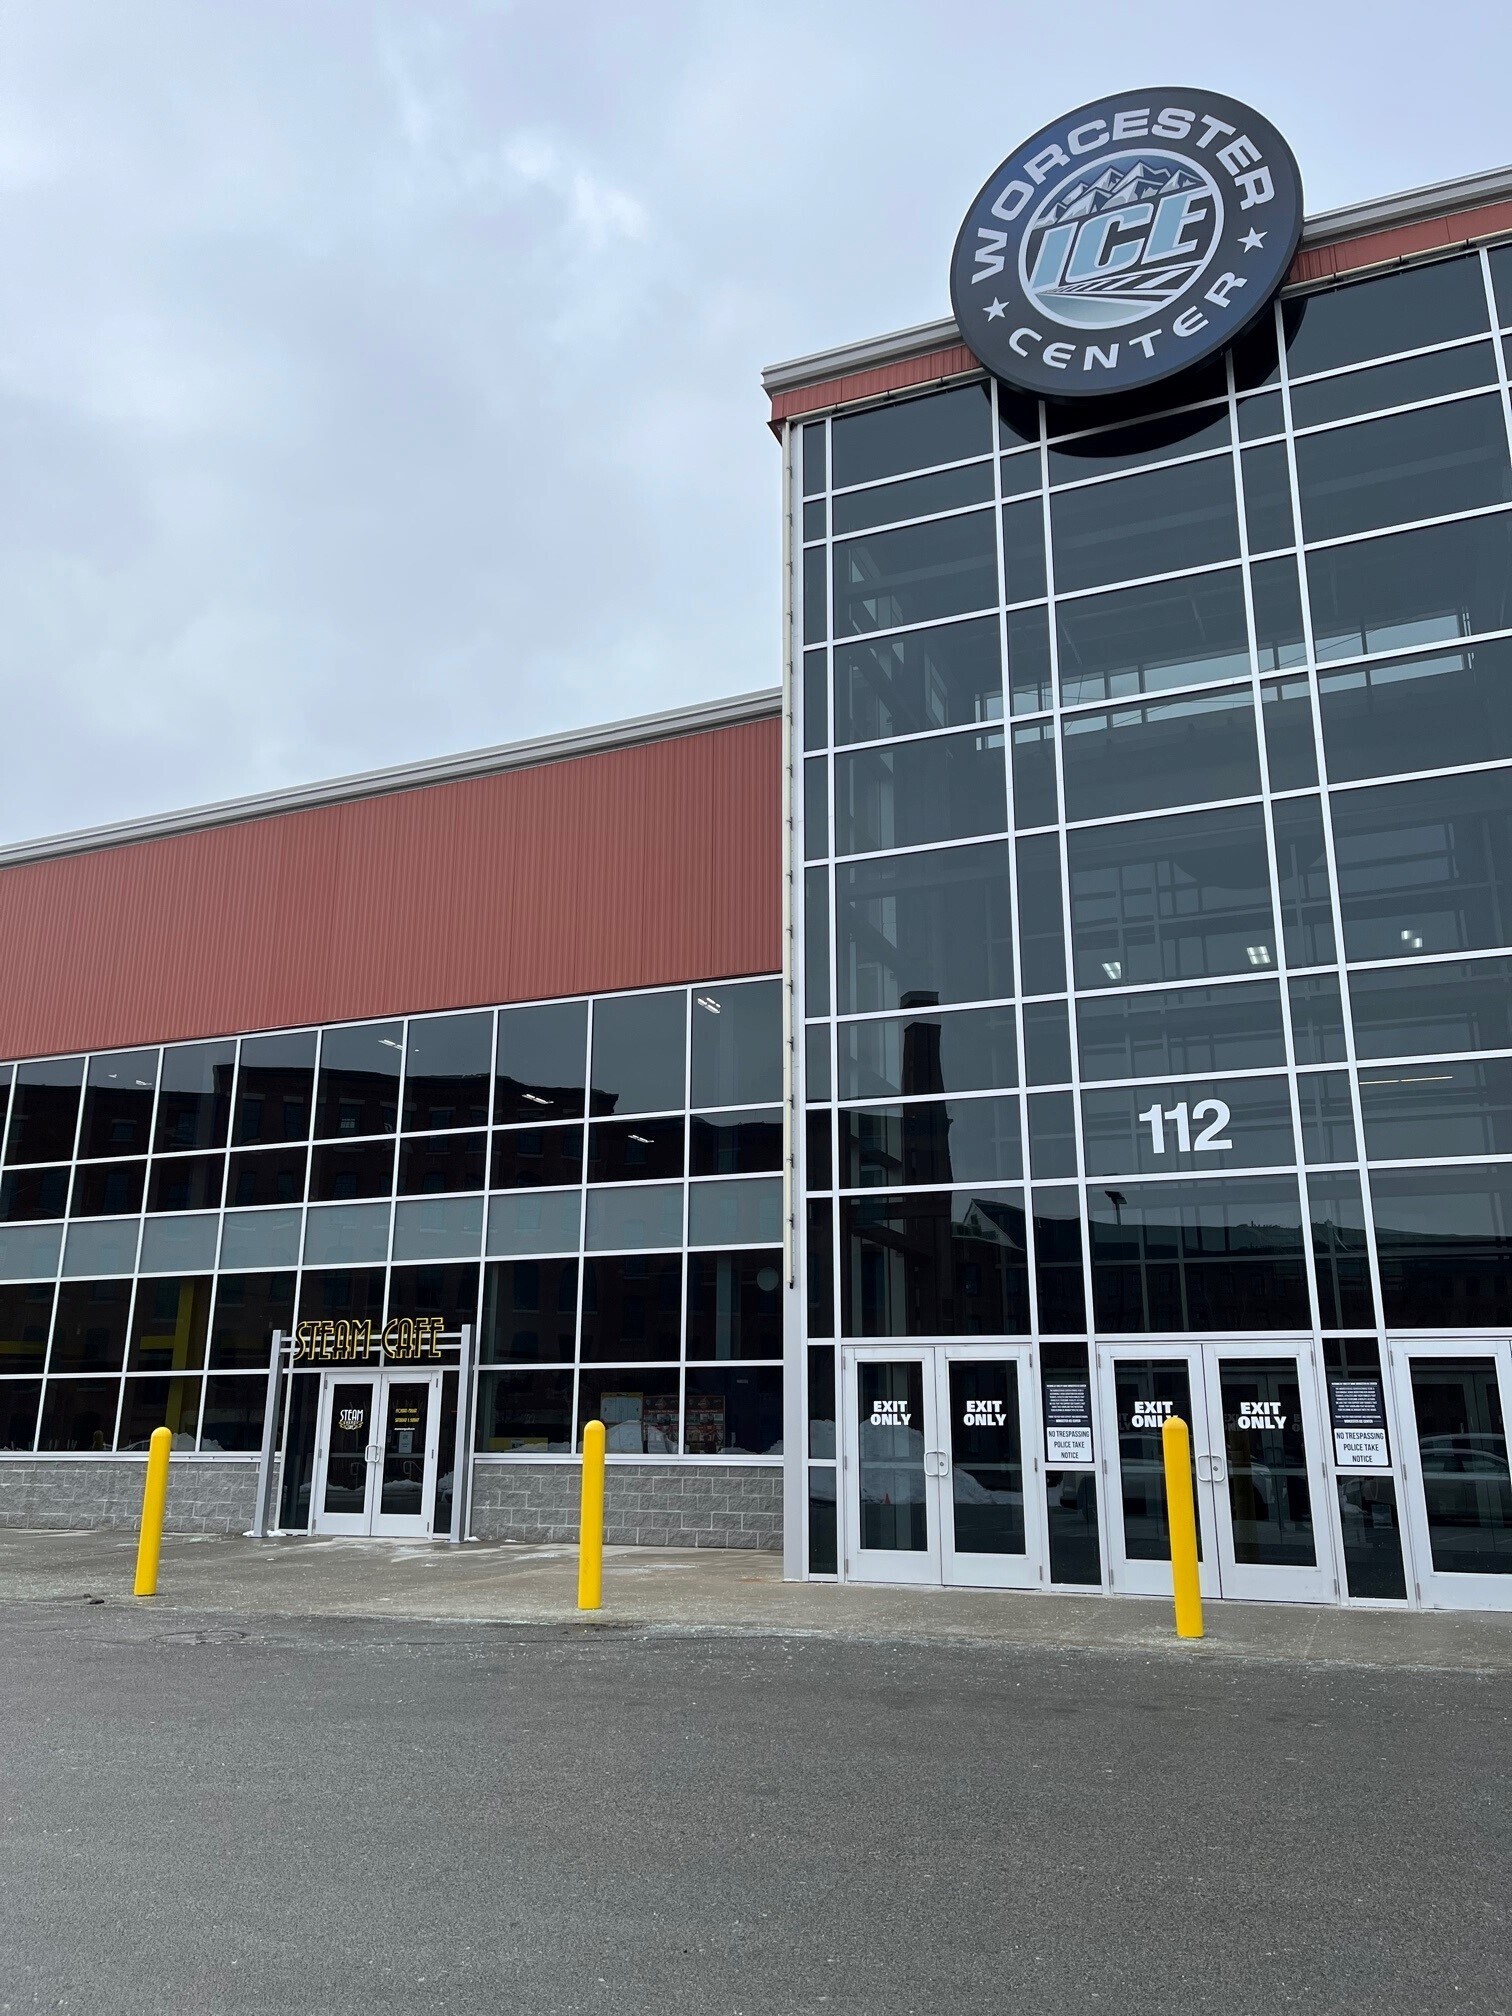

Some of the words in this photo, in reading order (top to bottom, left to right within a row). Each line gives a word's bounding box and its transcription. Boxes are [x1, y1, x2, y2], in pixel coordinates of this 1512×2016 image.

[971, 107, 1275, 285] WORCESTER
[1030, 184, 1214, 290] ICE
[1008, 271, 1248, 371] CENTER
[1138, 1099, 1233, 1154] 112
[293, 1319, 372, 1360] STEAM
[381, 1317, 445, 1359] CAFE
[873, 1400, 908, 1413] EXIT
[966, 1400, 1003, 1413] EXIT
[1134, 1401, 1174, 1414] EXIT
[1240, 1402, 1282, 1415] EXIT
[340, 1409, 364, 1421] STEAM
[870, 1413, 912, 1426] ONLY
[963, 1413, 1007, 1426] ONLY
[1131, 1414, 1179, 1428] ONL
[1237, 1416, 1287, 1430] ONLY
[1048, 1430, 1056, 1438] NO
[1056, 1430, 1090, 1438] TRESPASSING
[1336, 1432, 1345, 1440] NO
[1345, 1432, 1384, 1440] TRESPASSING
[1343, 1443, 1363, 1451] POLICE
[1364, 1443, 1379, 1451] TAKE
